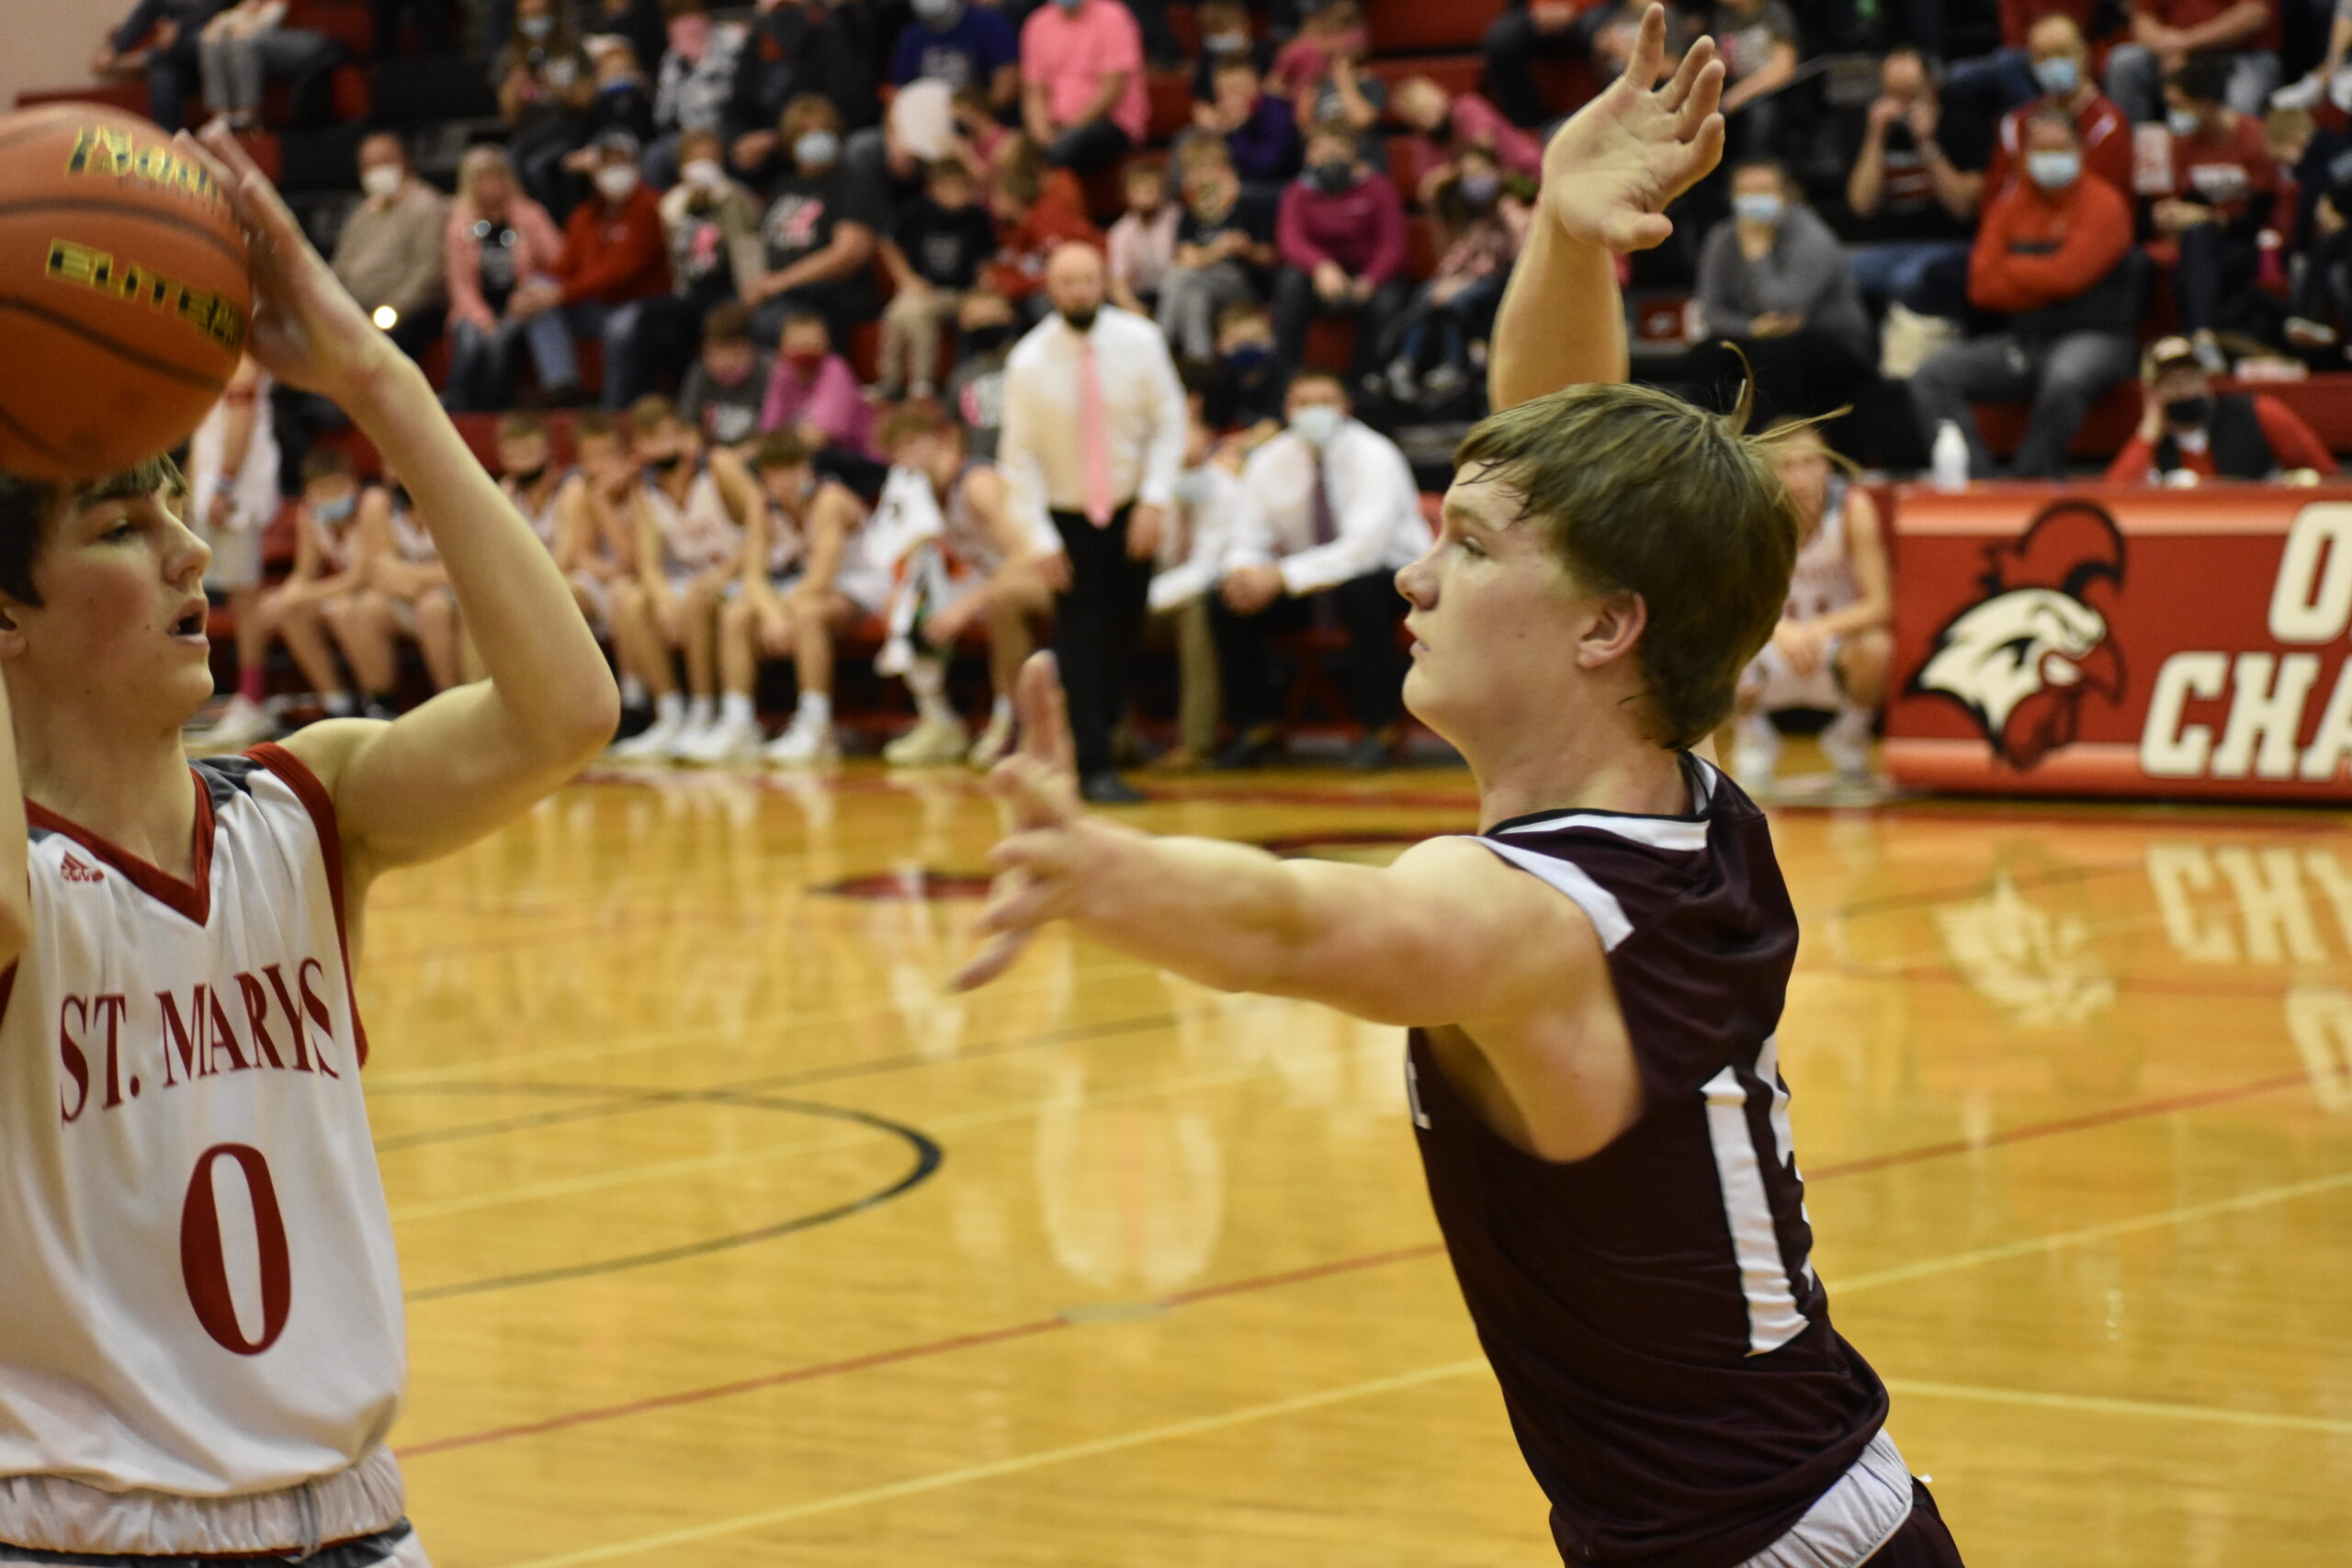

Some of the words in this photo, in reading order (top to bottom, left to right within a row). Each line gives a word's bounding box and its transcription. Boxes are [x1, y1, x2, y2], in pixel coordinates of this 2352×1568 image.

[60, 993, 140, 1131] ST.
[154, 956, 340, 1089] MARYS
[180, 1142, 291, 1355] 0
